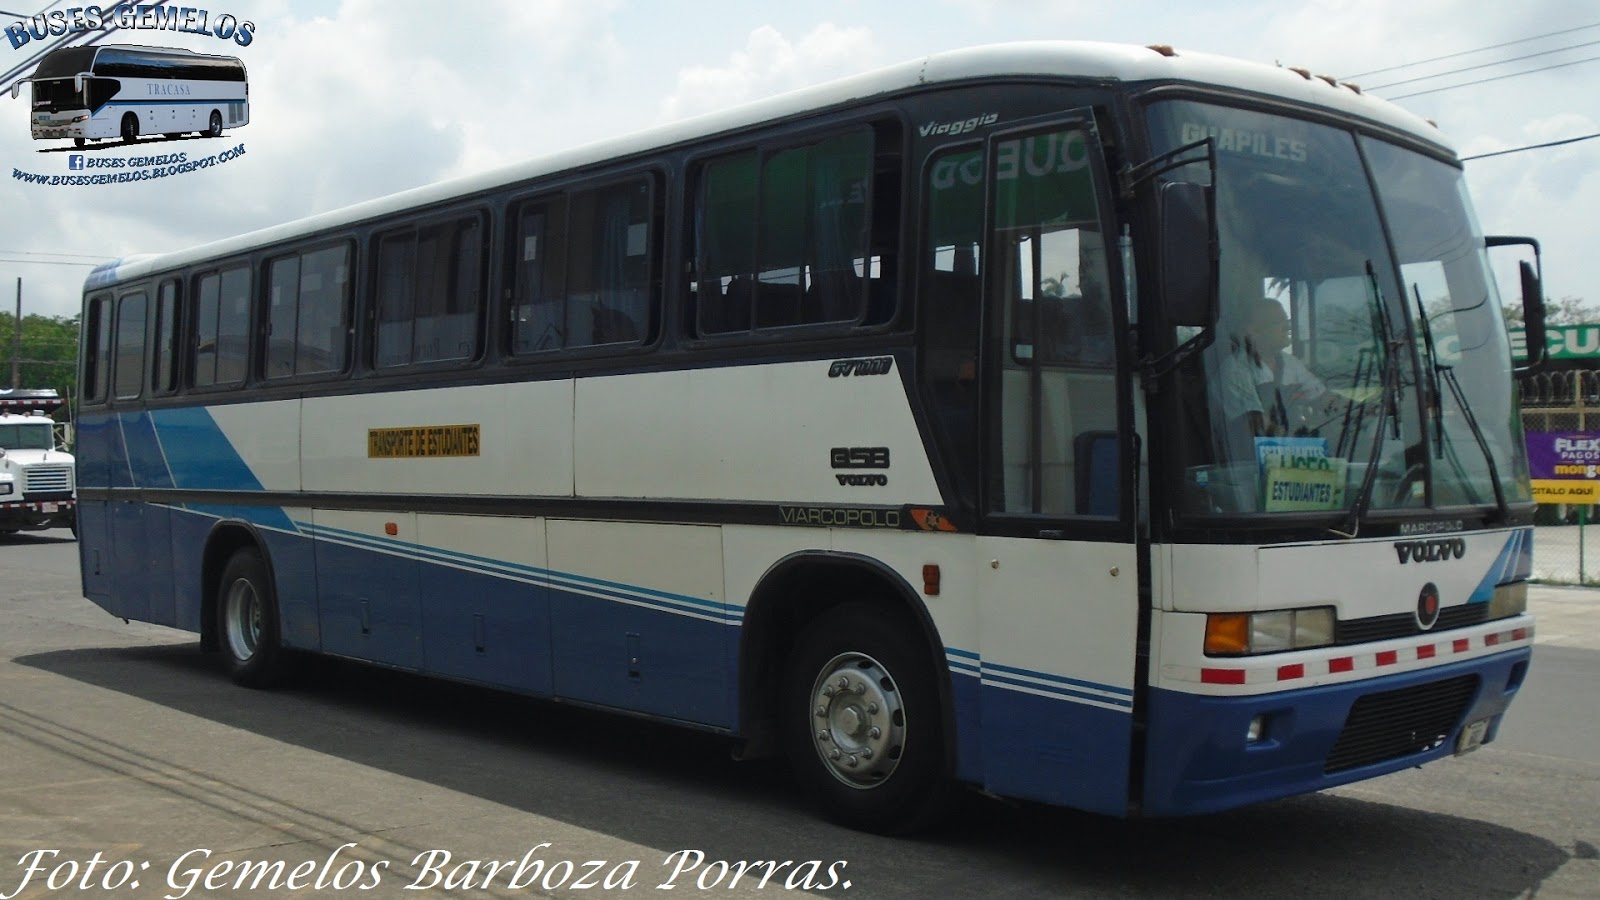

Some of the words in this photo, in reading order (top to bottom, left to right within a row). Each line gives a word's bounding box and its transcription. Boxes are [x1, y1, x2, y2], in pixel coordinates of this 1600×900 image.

[919, 113, 999, 137] Viaggio
[370, 429, 413, 456] TRANSPORTE
[415, 428, 426, 456] DE
[428, 426, 478, 455] ESTUDIANTES
[1561, 451, 1600, 460] PAGOS
[835, 474, 888, 486] VOLVO
[1272, 480, 1332, 503] ESTUDIANTES
[779, 508, 900, 527] MARCOPOLO
[1400, 520, 1464, 533] MARCOPOLO
[1394, 538, 1466, 564] VOLVO
